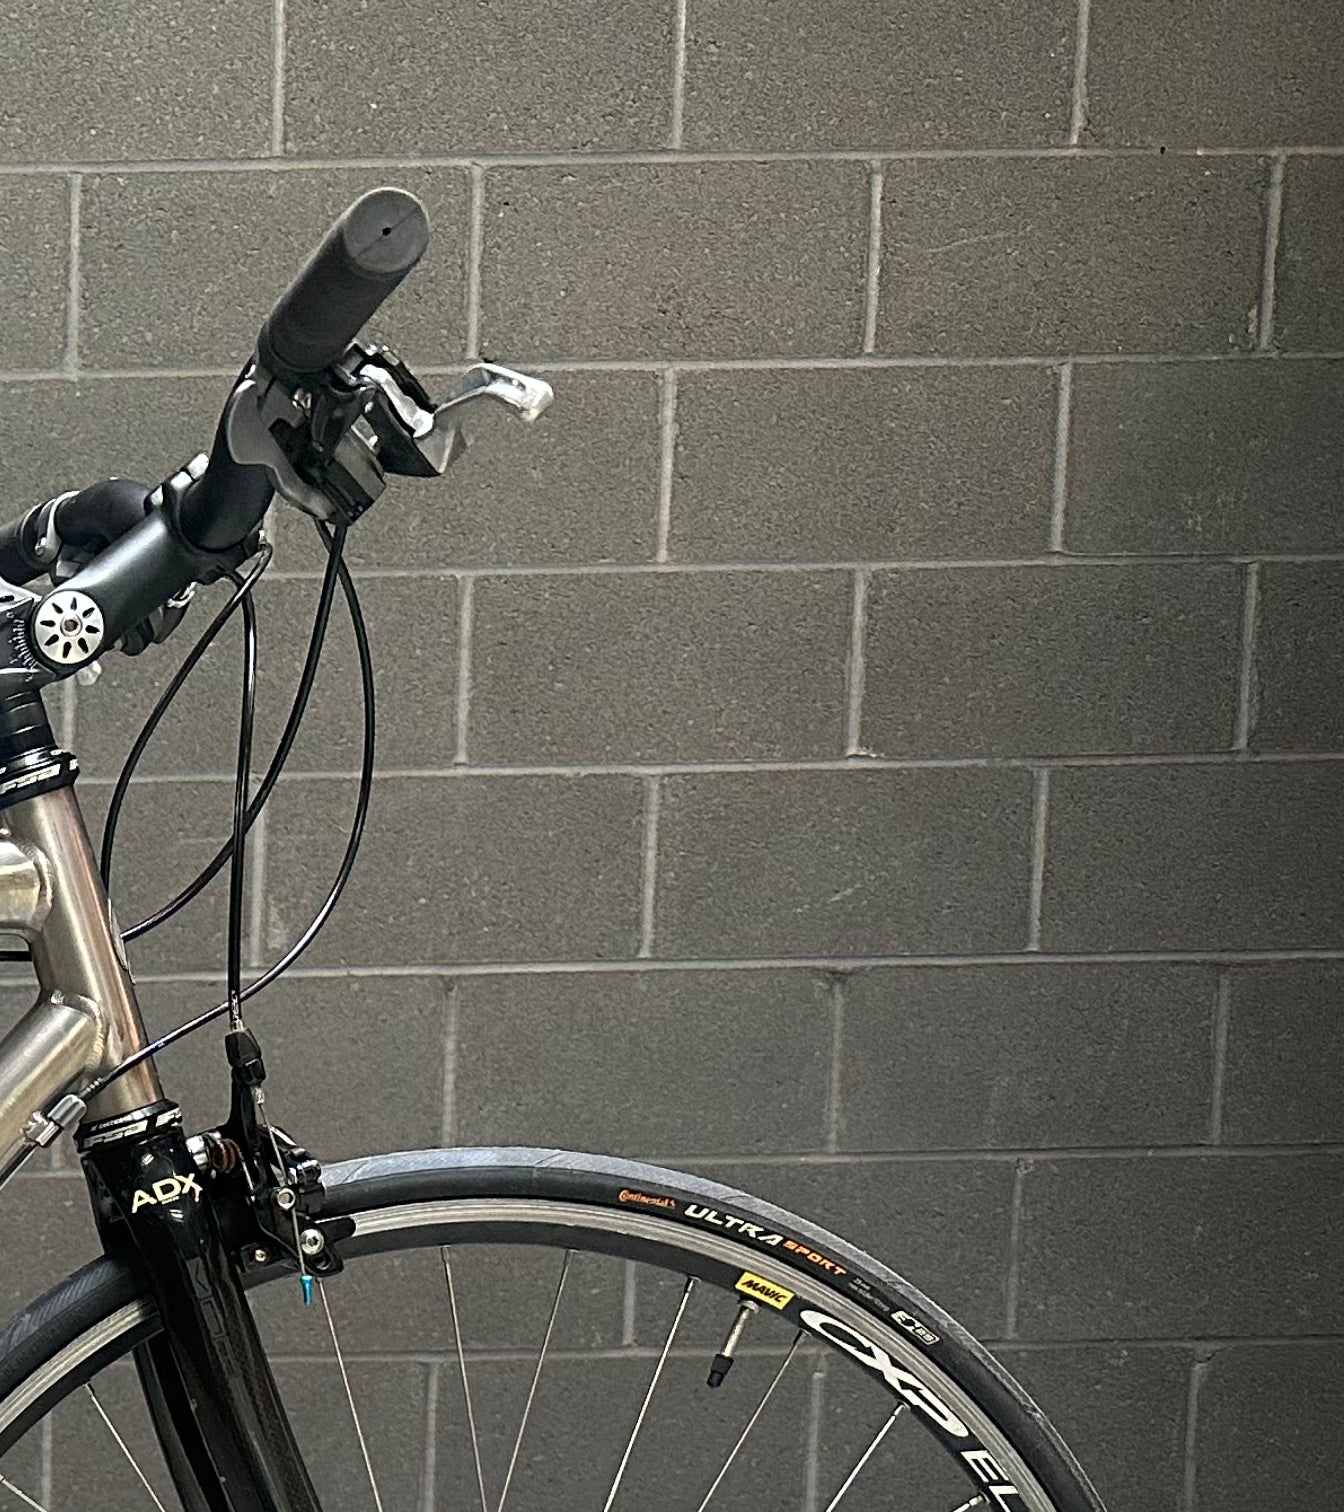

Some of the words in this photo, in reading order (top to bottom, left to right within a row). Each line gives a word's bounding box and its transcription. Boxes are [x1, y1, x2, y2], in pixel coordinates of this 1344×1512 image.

[131, 1172, 204, 1214] ADX
[618, 1189, 669, 1208] Continental
[683, 1203, 785, 1246] ULTRA
[782, 1239, 848, 1276] SPORT
[741, 1279, 789, 1303] MAVIC
[800, 1309, 970, 1438] CXP
